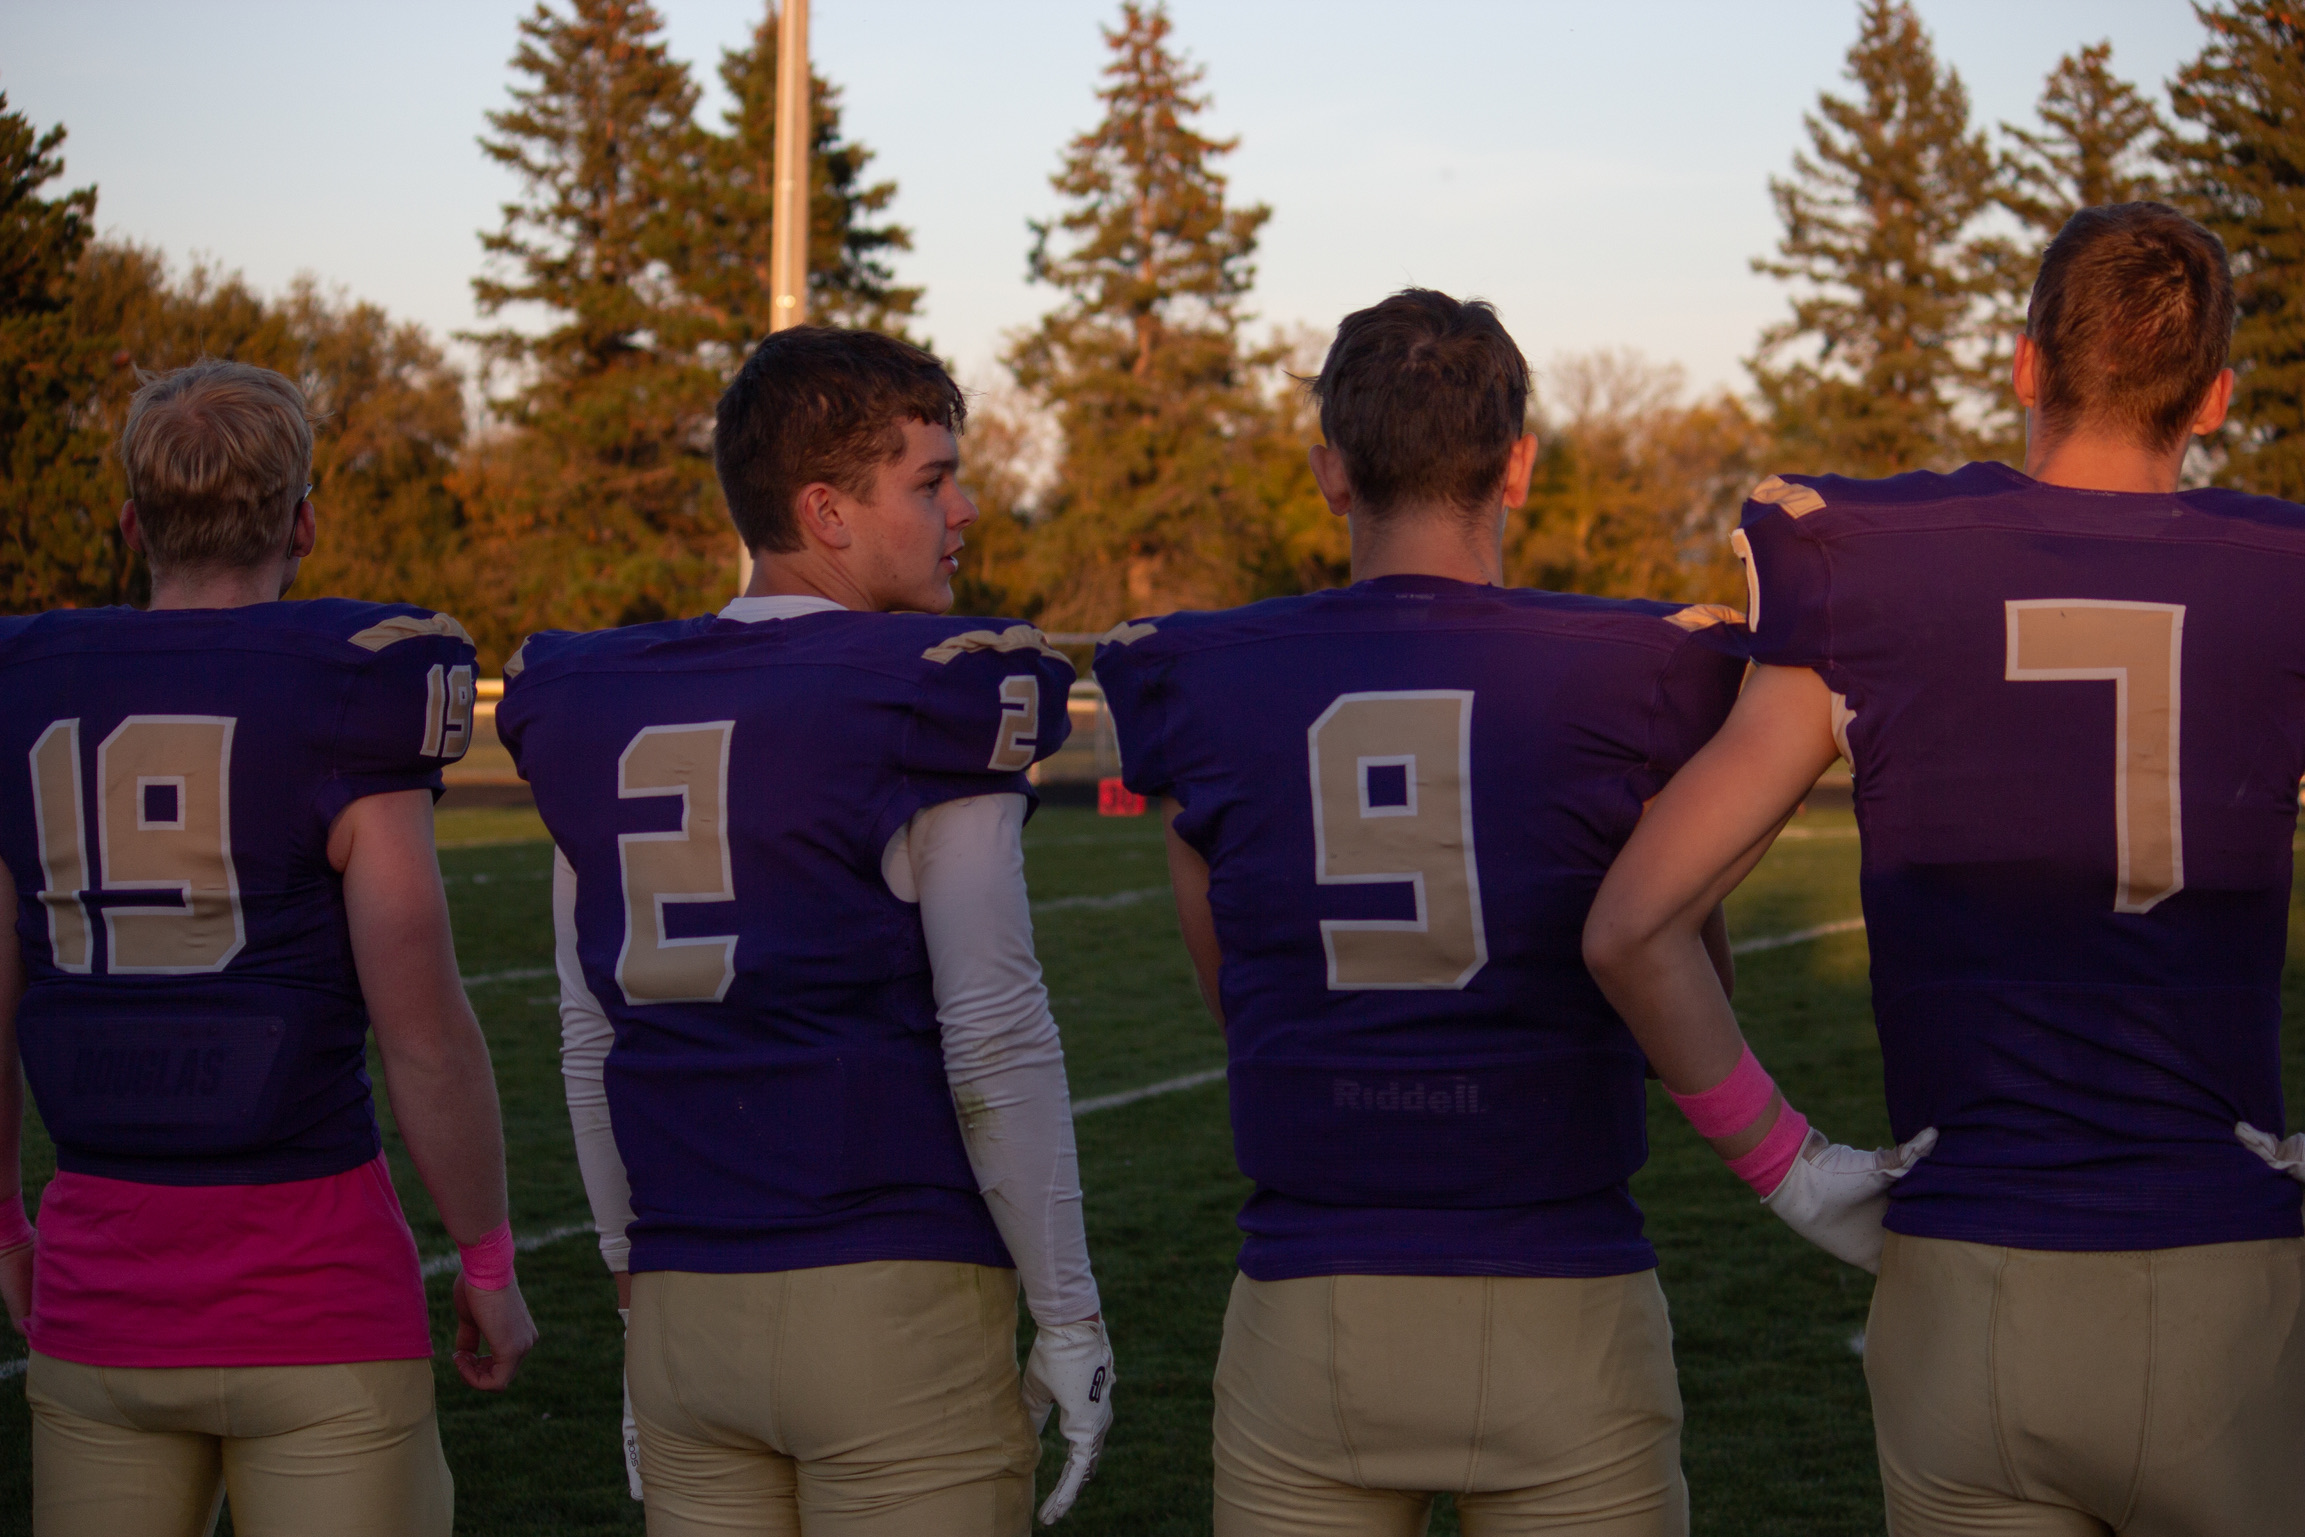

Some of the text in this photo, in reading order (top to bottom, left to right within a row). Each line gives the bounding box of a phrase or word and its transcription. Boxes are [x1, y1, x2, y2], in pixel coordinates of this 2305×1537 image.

[28, 713, 247, 975] 19
[419, 663, 474, 759] 19
[987, 674, 1039, 772] 2
[1307, 689, 1489, 991] 9
[2004, 597, 2187, 916] 7
[614, 720, 740, 1006] 2
